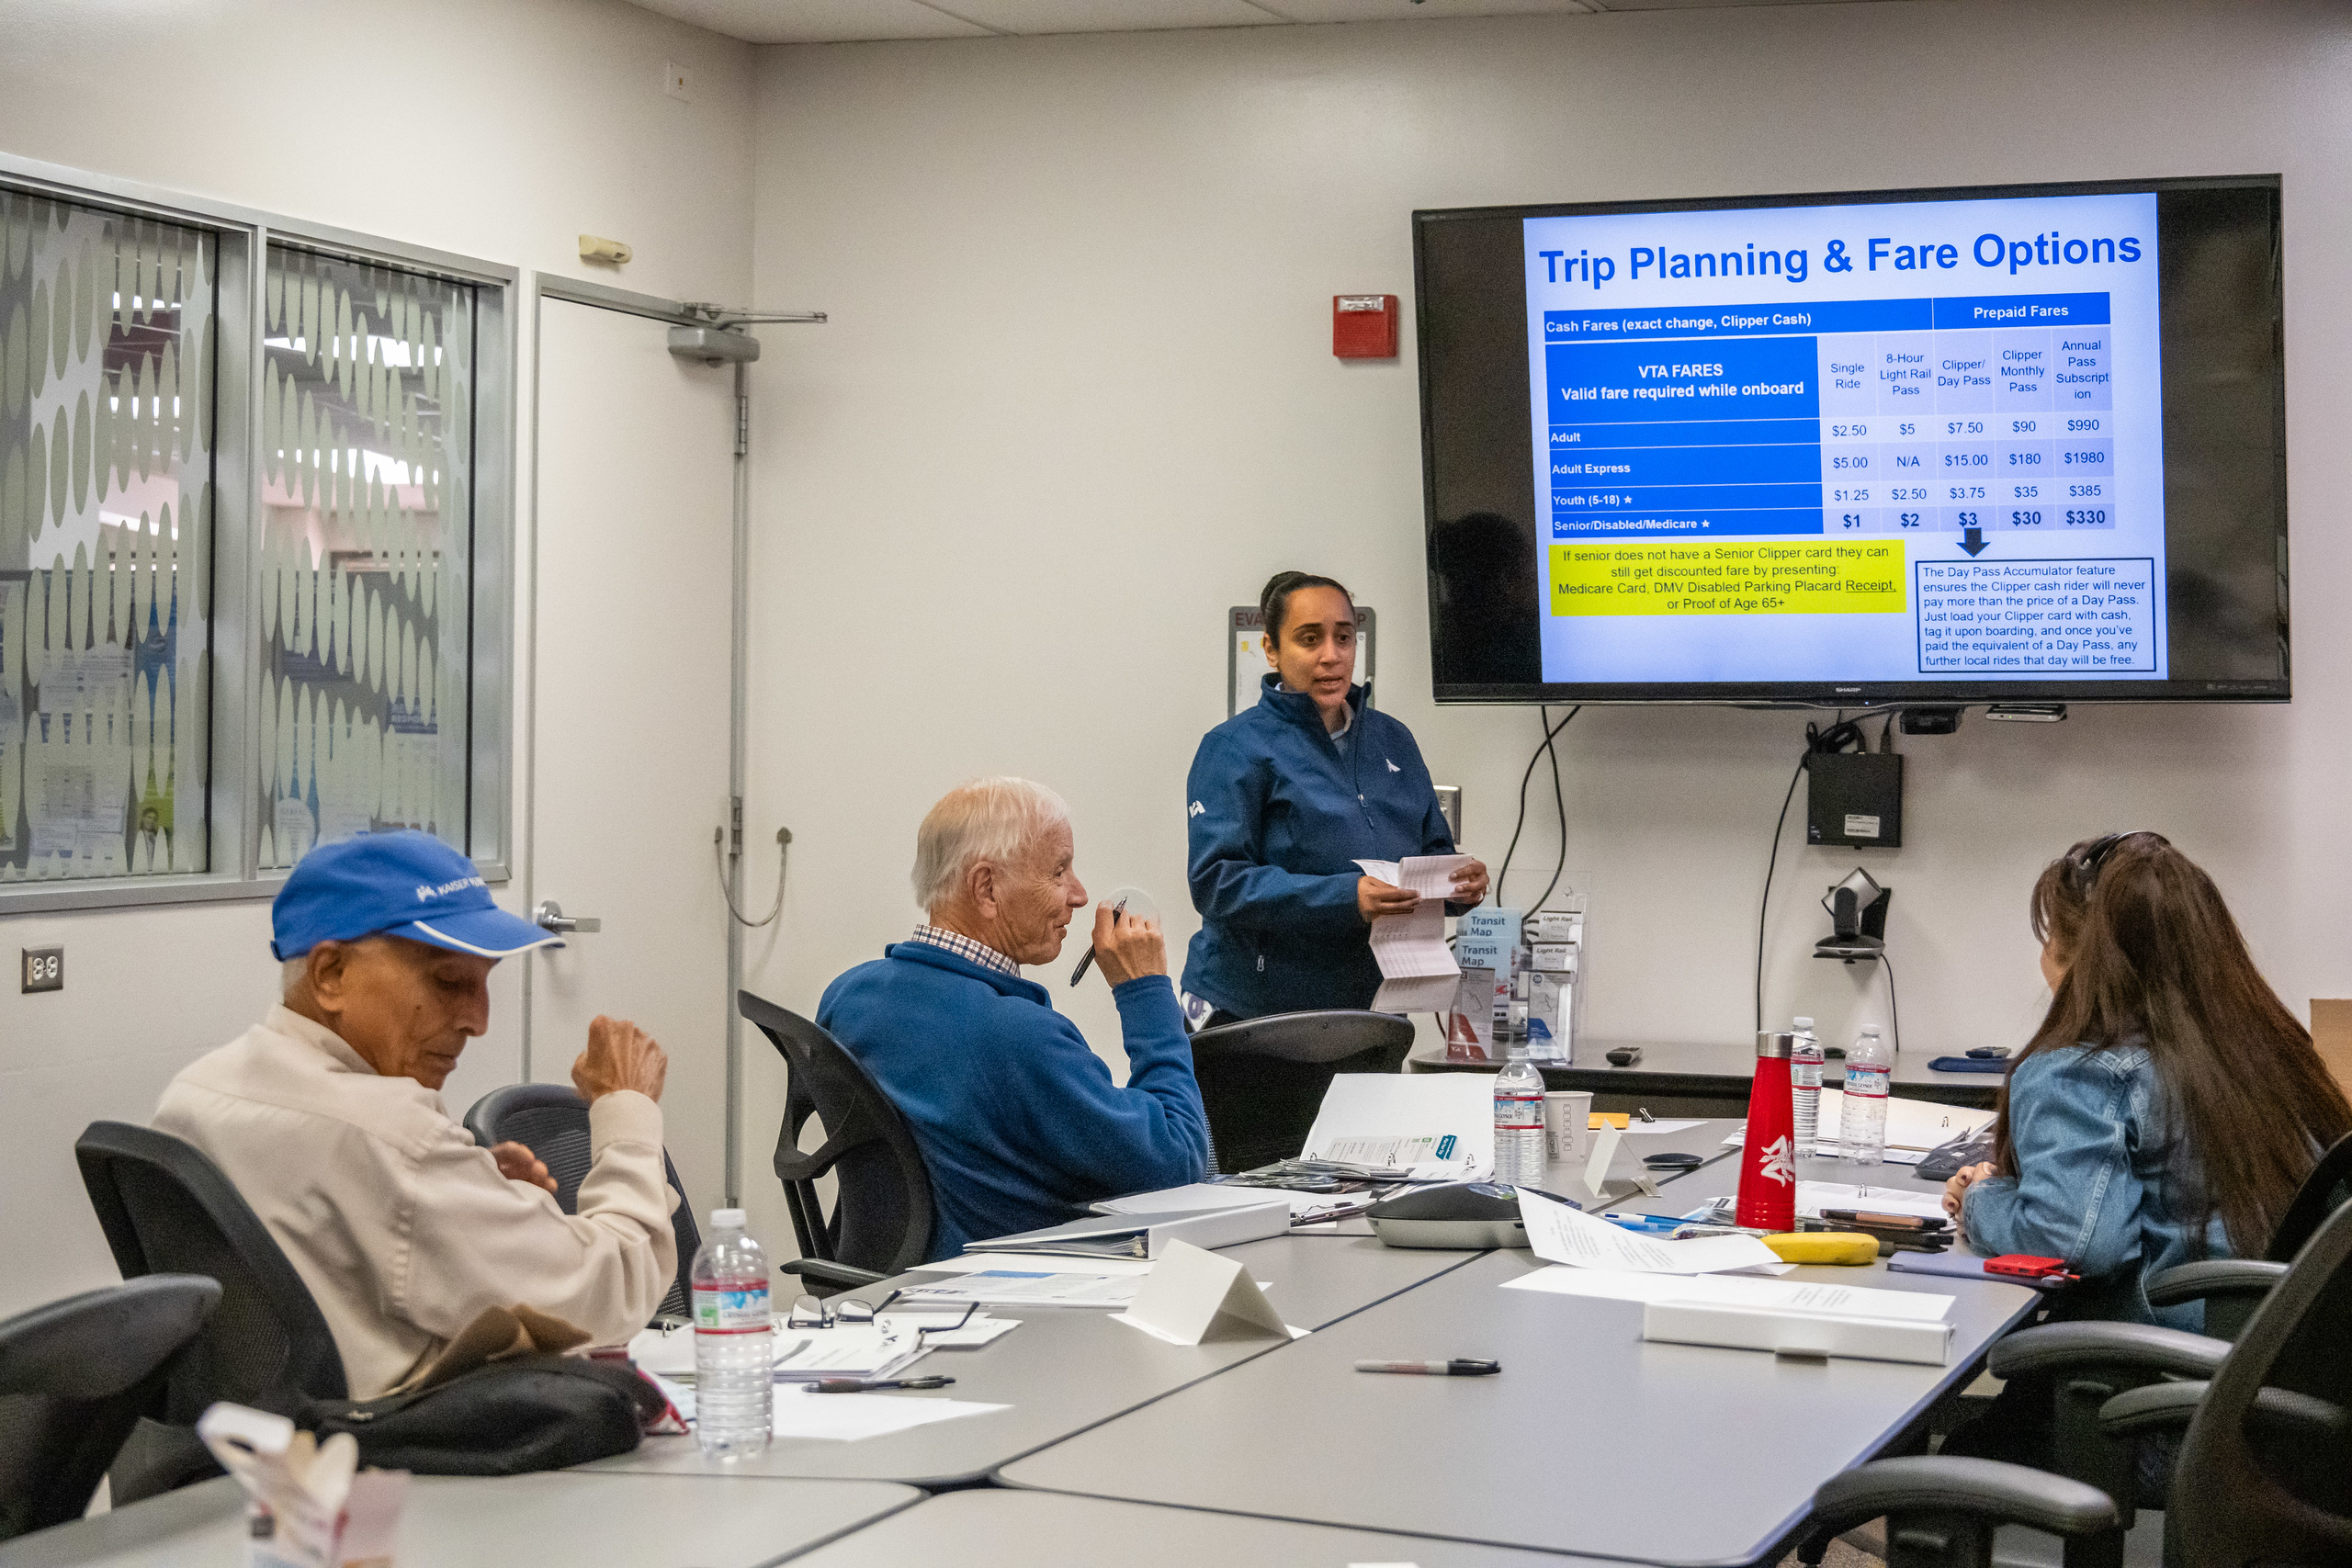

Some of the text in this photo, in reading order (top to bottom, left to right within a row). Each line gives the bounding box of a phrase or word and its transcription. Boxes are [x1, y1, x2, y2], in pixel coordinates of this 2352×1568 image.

[1539, 231, 2143, 290] Trip Planning & Fare Options
[1973, 305, 2069, 321] Prepaid Fares
[1545, 312, 1812, 334] Cash Fares (exact change, Clipper Cash)
[2061, 340, 2101, 351] Annual
[1885, 353, 1924, 364] 8-Hour
[2002, 349, 2042, 362] Clipper
[2067, 356, 2097, 367] Pass
[1637, 363, 1724, 378] VTA FARES
[1830, 362, 1865, 376] Single
[1941, 358, 1985, 372] Clipper/
[2000, 365, 2045, 378] Monthly
[1879, 368, 1931, 382] Light Rail
[2055, 372, 2109, 385] Subscript
[1835, 378, 1860, 389] Ride
[1937, 375, 1991, 389] Day Pass
[2008, 381, 2038, 392] Pass
[1560, 380, 1804, 401] Valid fare required while onboard
[1892, 385, 1920, 395] Pass
[2074, 390, 2091, 400] ion
[1831, 424, 1867, 437] $2.50
[1899, 423, 1916, 435] $5
[1947, 421, 1984, 434] $7.50
[2012, 420, 2036, 433] $90
[2067, 418, 2099, 432] $990
[1550, 432, 1581, 443] Adult
[1832, 456, 1868, 469] $5.00
[1896, 455, 1920, 467] N/A
[1944, 454, 1988, 467] $15.00
[2008, 452, 2041, 466] $180
[2064, 451, 2105, 464] $1980
[1551, 463, 1631, 476] Adult Express
[1834, 489, 1870, 502] $1.25
[1891, 488, 1927, 501] $2.50
[1949, 486, 1985, 500] $3.75
[2014, 485, 2038, 498] $35
[2068, 484, 2101, 497] $385
[1553, 494, 1620, 507] Youth (5-18)
[1842, 513, 1860, 529] $1
[1900, 512, 1919, 528] $2
[1958, 511, 1978, 527] $3
[2011, 510, 2041, 526] $30
[2065, 509, 2105, 525] $330
[1554, 518, 1698, 531] Senior/Disabled/Medicare
[1563, 546, 1889, 561] If senior does not have a Senior Clipper card they can
[1611, 564, 1841, 580] still get discounted fare by presenting:
[1922, 565, 2116, 579] The Day Pass Accumulator feature
[1557, 580, 1896, 594] Medicare Card, DMV Disabled Parking Placard Receipt,
[1923, 580, 2145, 593] ensures the Clipper cash rider will never
[1667, 596, 1785, 611] or Proof of Age 65+
[1923, 594, 2139, 609] pay more than the price of a Day Pass.
[1924, 609, 2131, 624] Just load your Clipper card with cash,
[1924, 626, 1941, 639] tag
[1944, 626, 1951, 636] it
[1954, 627, 1982, 638] upon
[1985, 626, 2037, 638] boarding,
[2041, 626, 2062, 636] and
[2064, 626, 2092, 636] once
[1925, 639, 2138, 653] paid the equivalent of a Day Pass, any
[1925, 654, 2134, 667] further local rides that day will be free.
[436, 877, 470, 896] KAISER
[1471, 916, 1506, 926] Transit
[1470, 927, 1492, 937] Map
[1462, 945, 1498, 954] Transit
[1461, 957, 1485, 966] Map
